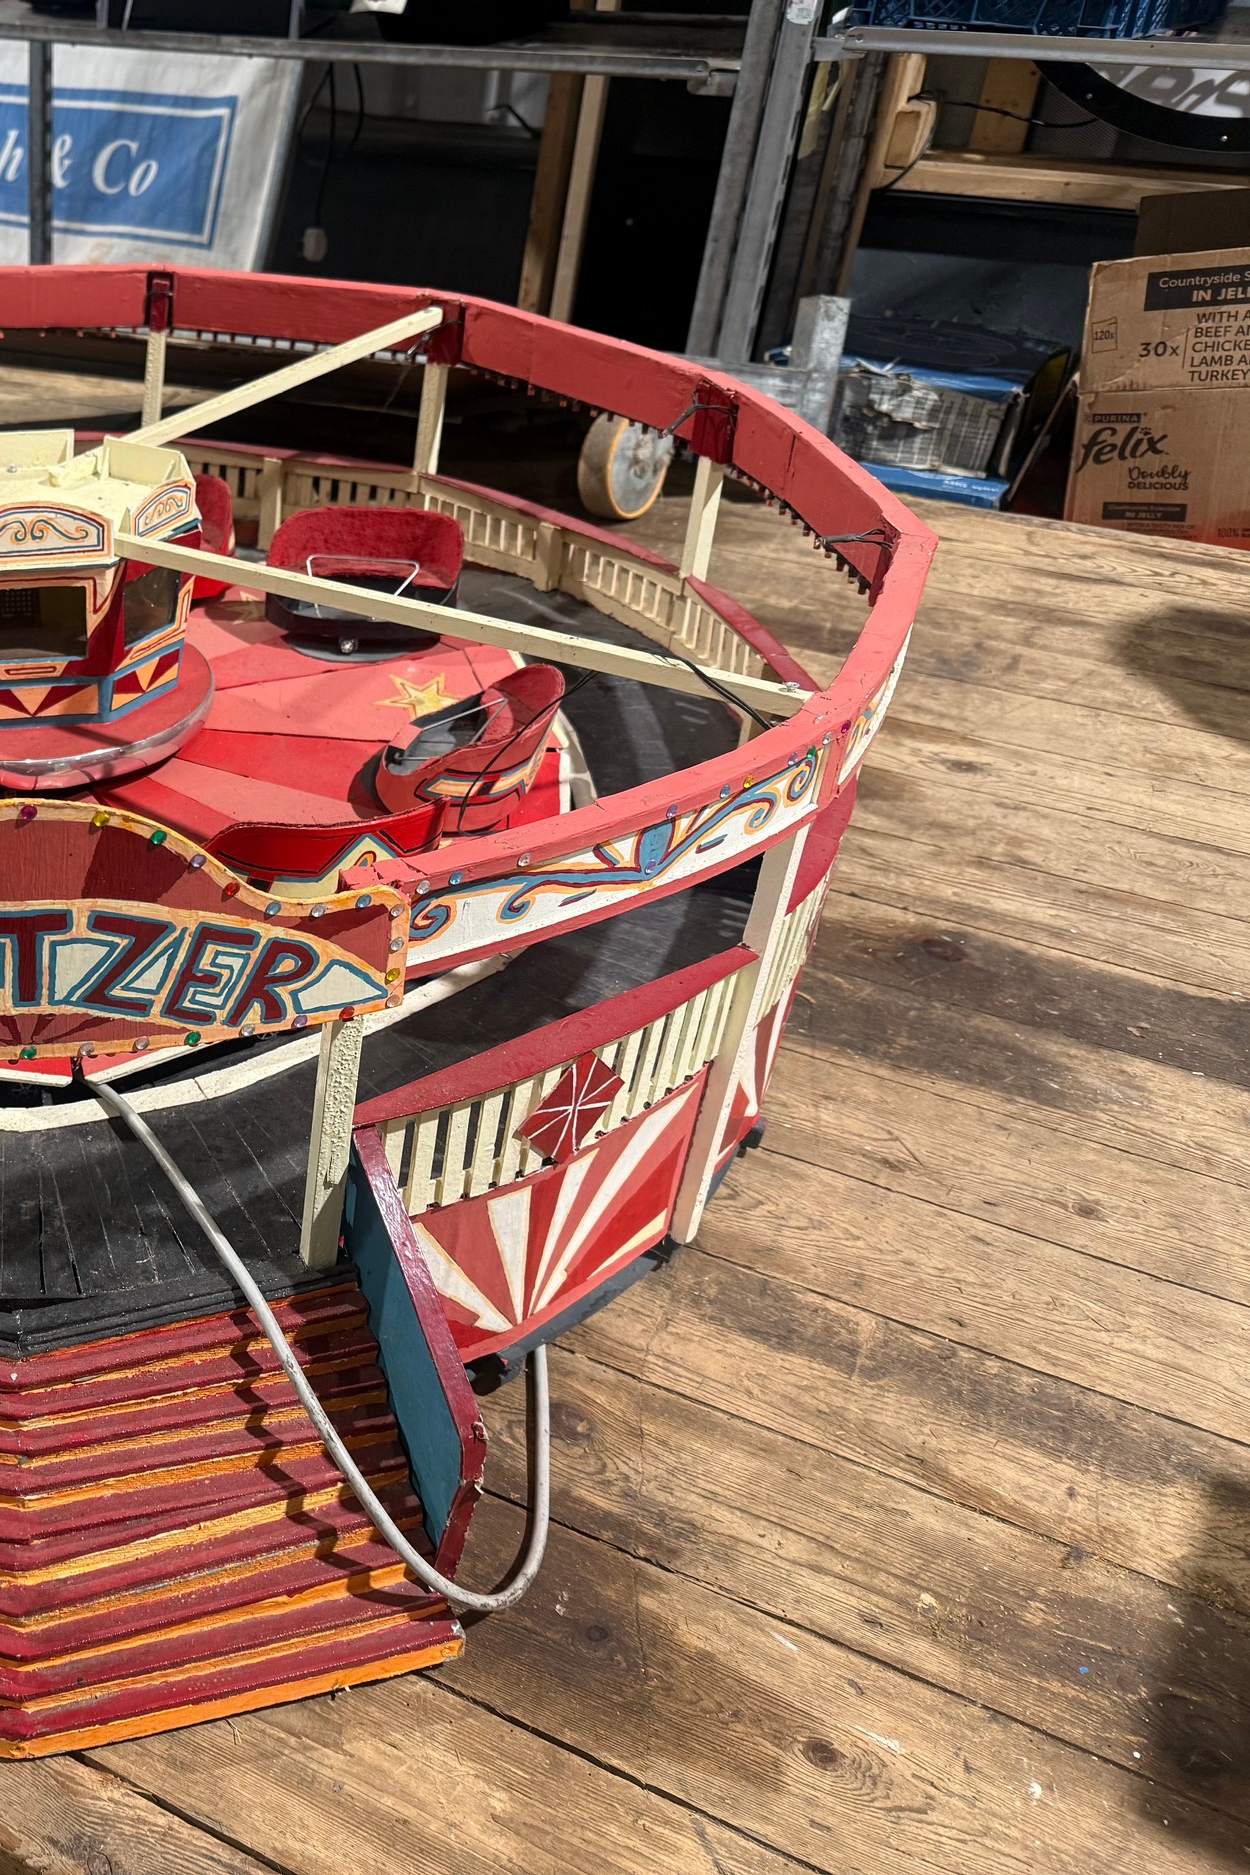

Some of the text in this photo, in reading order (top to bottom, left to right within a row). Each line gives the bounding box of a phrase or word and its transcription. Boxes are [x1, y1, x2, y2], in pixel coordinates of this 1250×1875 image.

[52, 134, 73, 189] &
[92, 138, 159, 197] Co
[1159, 273, 1241, 289] Countryside
[1191, 289, 1212, 303] IN
[1196, 310, 1239, 324] WITH
[1094, 330, 1115, 341] 120x
[1194, 326, 1232, 339] BEEF
[1138, 341, 1180, 358] 30x
[1190, 355, 1234, 368] LAMB
[1188, 369, 1249, 382] TURKEY
[1094, 414, 1139, 423] PURINA
[1075, 426, 1168, 474] felix
[1128, 464, 1192, 484] Doubly
[1127, 481, 1189, 491] DELICIOUS
